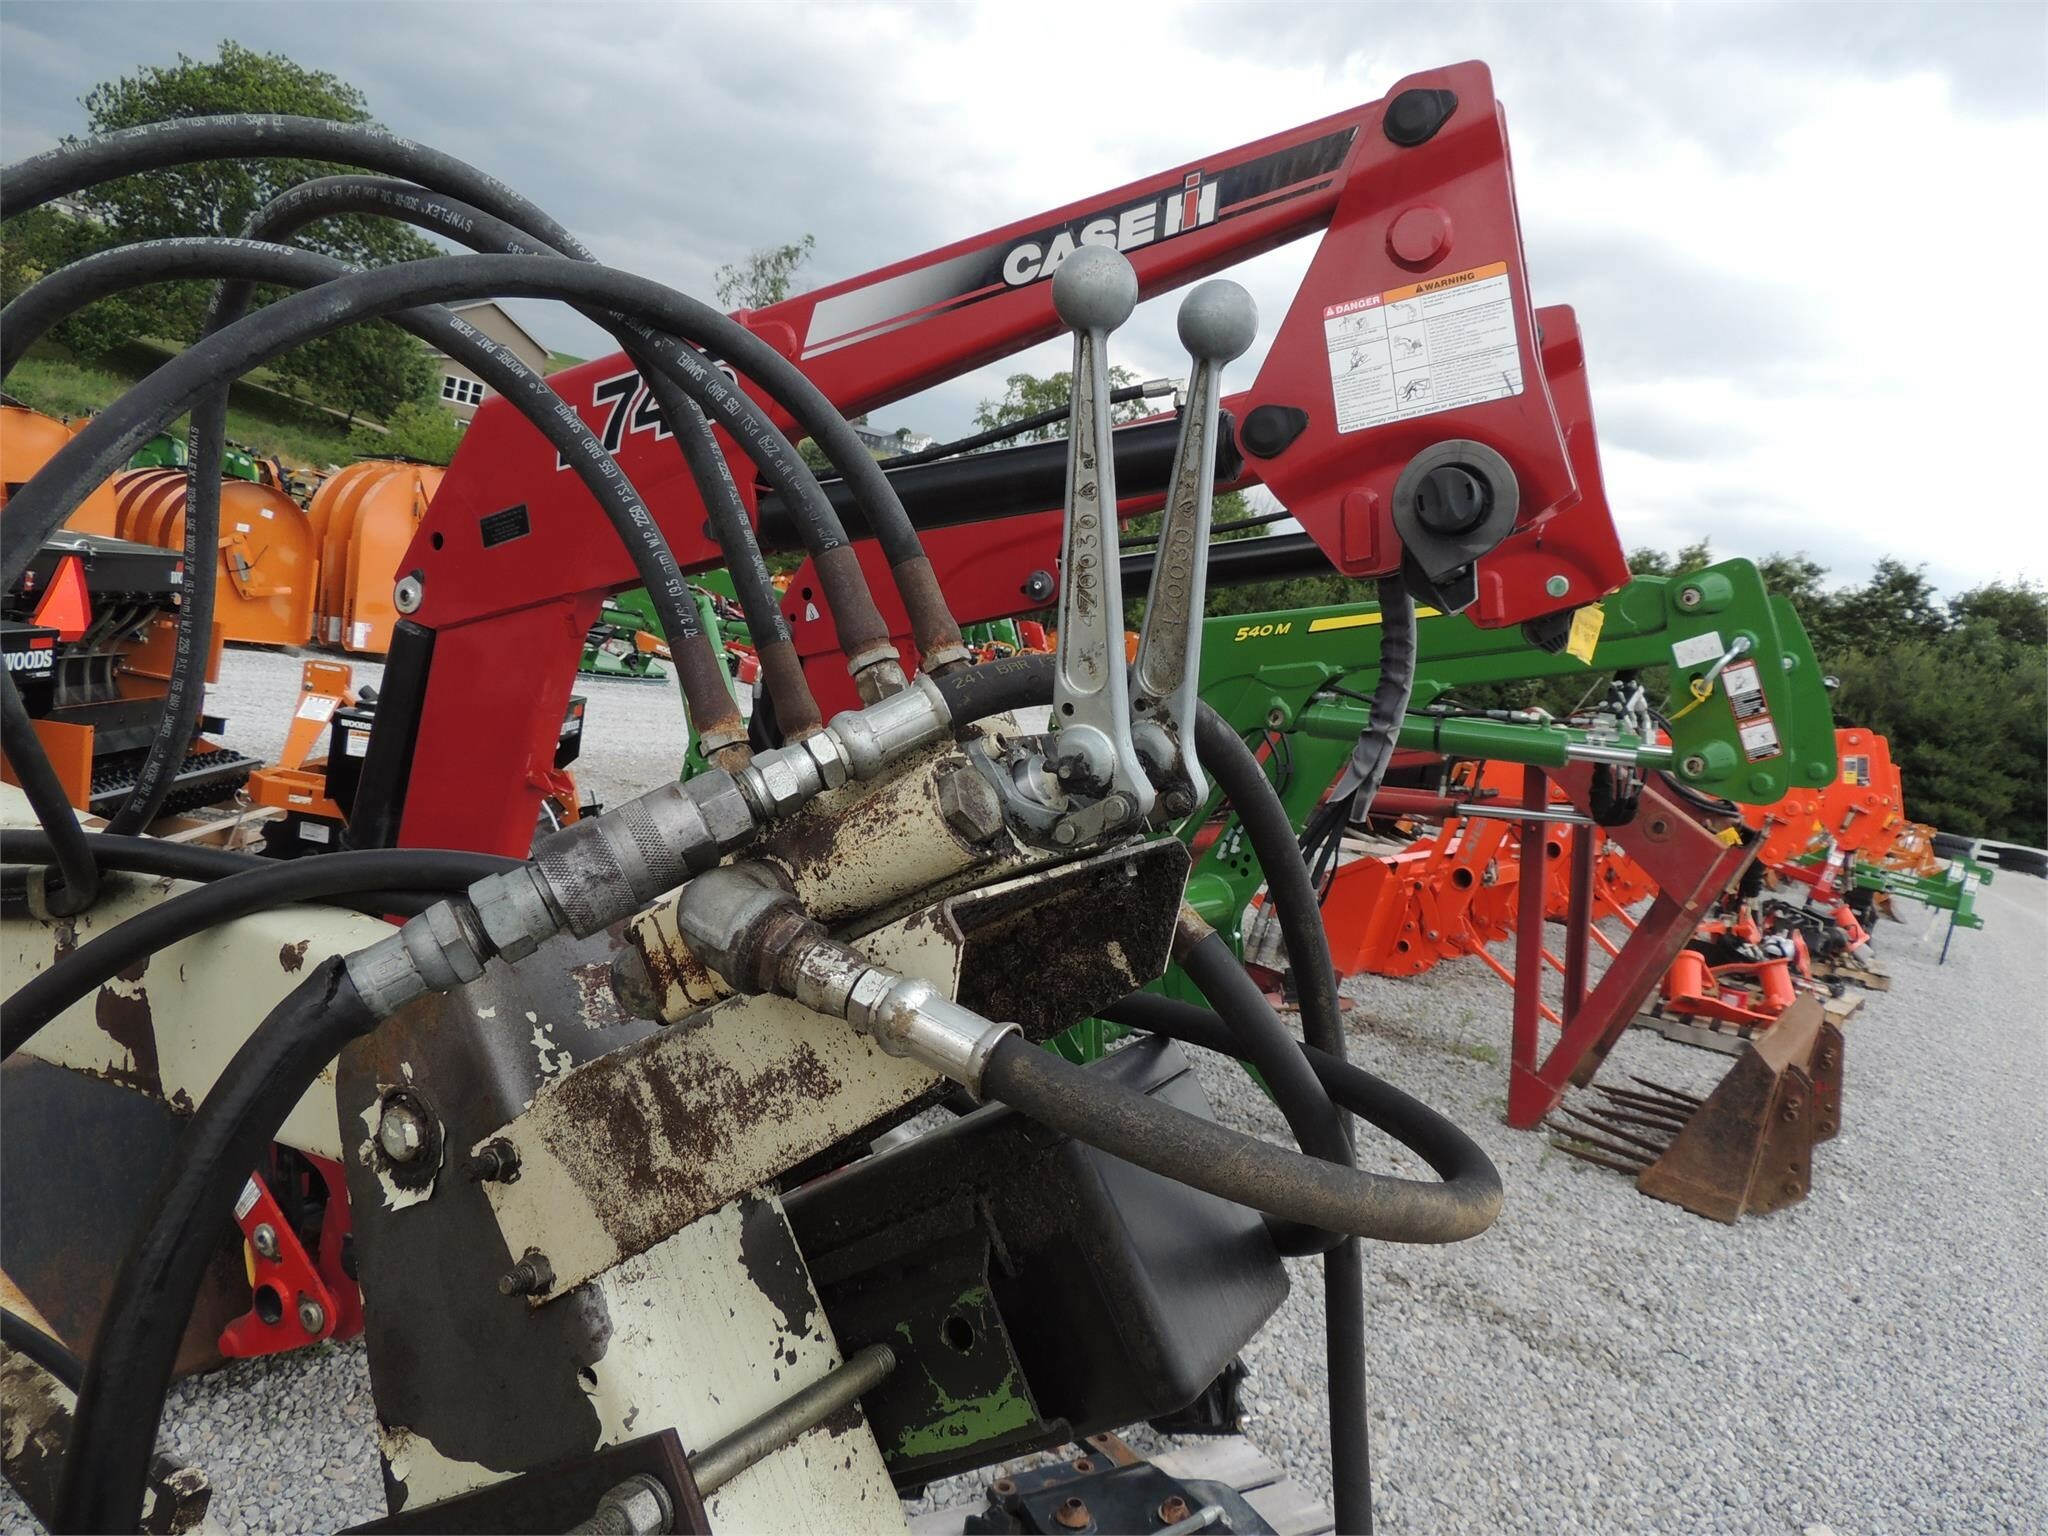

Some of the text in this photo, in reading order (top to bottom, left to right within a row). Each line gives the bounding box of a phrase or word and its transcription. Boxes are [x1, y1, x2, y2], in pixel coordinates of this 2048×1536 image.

[1003, 202, 1158, 287] CASE
[1425, 272, 1476, 291] WARNING
[1335, 295, 1381, 315] DANGER
[449, 315, 476, 338] PEND.
[475, 335, 498, 354] PAT.
[495, 349, 529, 379] MOORE
[676, 350, 709, 382] SAMUEL
[704, 378, 729, 402] BAR)
[553, 401, 586, 434] SAMUEL
[187, 425, 200, 478] SYNFLEX
[581, 436, 605, 461] BAR)
[758, 434, 781, 458] 2250
[598, 460, 618, 480] (155
[628, 504, 650, 528] 2250
[2, 649, 53, 671] WOODS
[951, 670, 985, 690] 241
[995, 658, 1031, 676] BAR
[340, 718, 372, 731] WOODS
